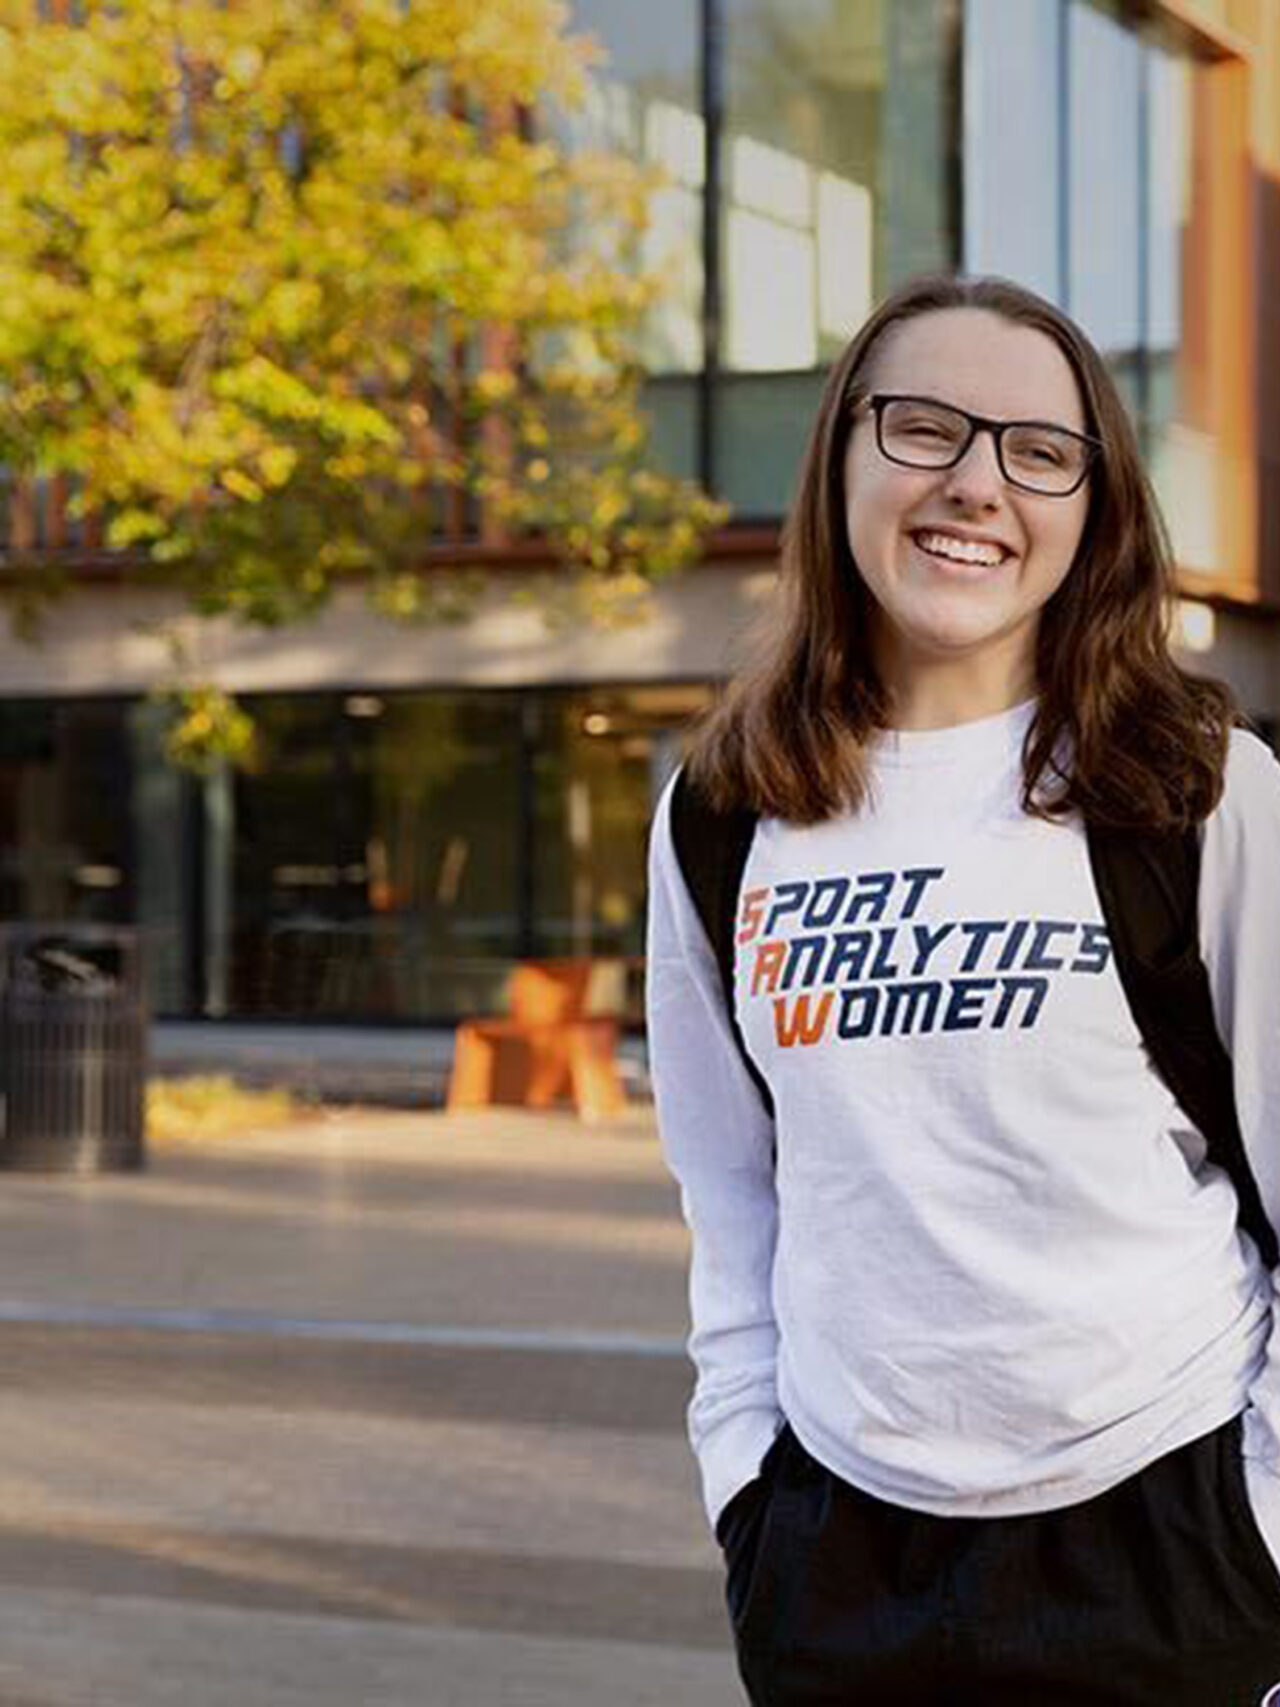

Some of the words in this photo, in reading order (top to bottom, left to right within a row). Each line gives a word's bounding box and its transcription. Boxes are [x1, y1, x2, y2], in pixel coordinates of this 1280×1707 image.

[738, 868, 945, 944] SPORT
[750, 920, 1112, 997] ANALYTICS
[773, 976, 1050, 1048] WOMEN
